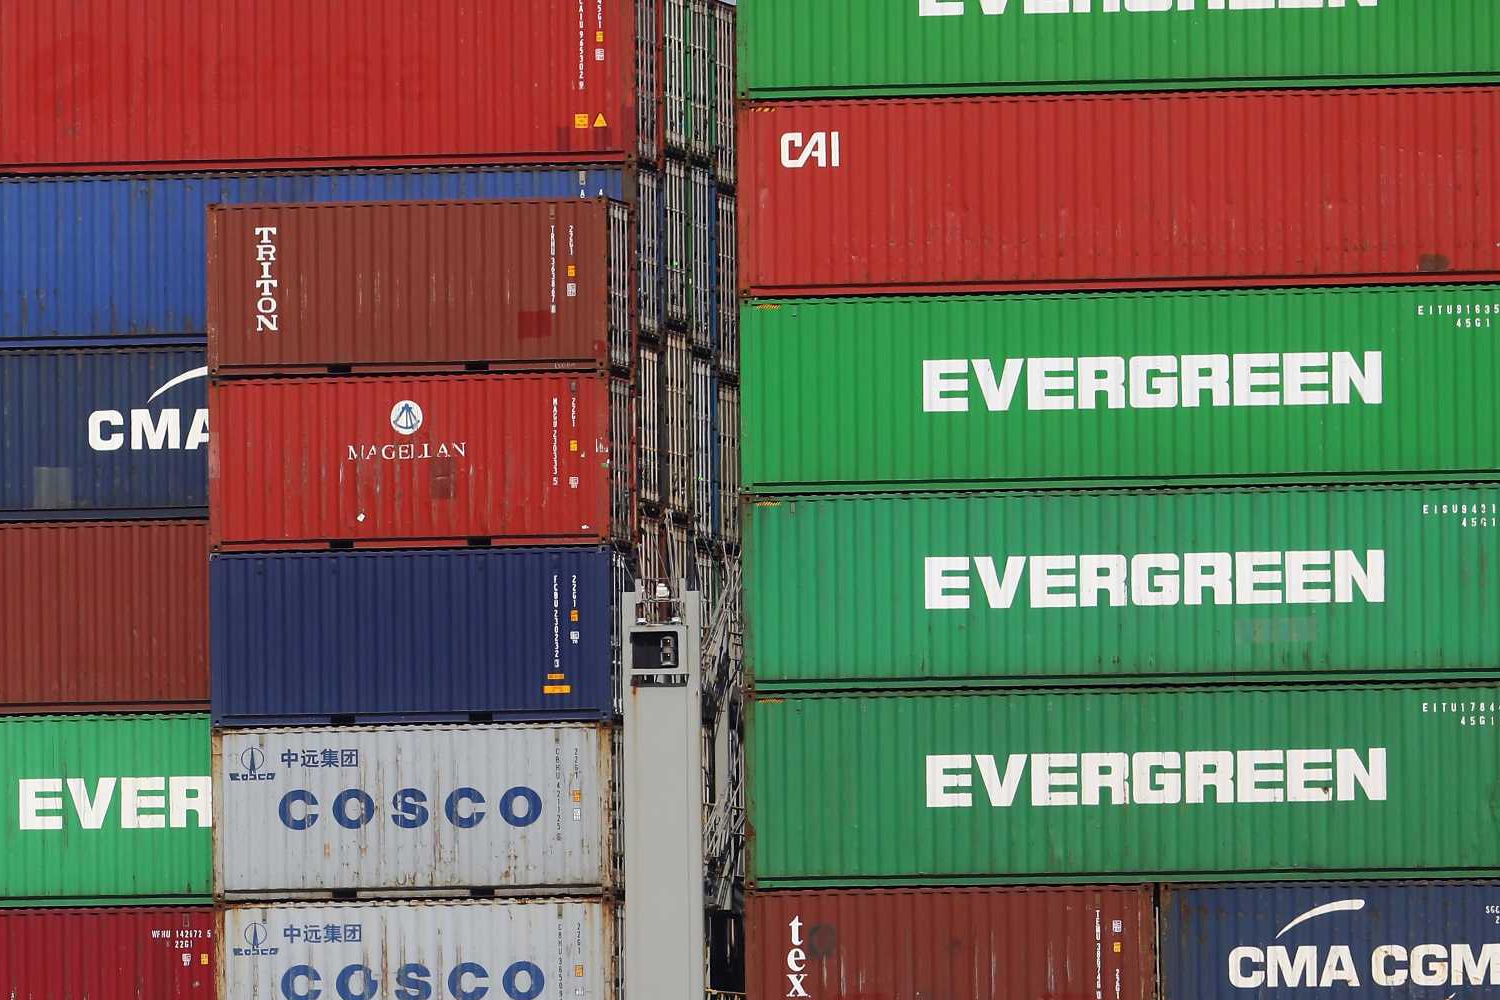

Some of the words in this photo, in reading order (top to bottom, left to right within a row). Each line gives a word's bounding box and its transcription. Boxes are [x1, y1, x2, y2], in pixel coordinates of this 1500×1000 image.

[780, 131, 841, 168] CAI
[255, 226, 279, 332] TRITON
[1456, 318, 1490, 328] 45G1
[922, 351, 1383, 413] EVERGREEN
[348, 442, 467, 461] MAGELLAN
[924, 549, 1385, 610] EVERGREEN
[1422, 702, 1500, 713] EITU1784
[281, 748, 359, 768] 中远集团
[926, 748, 1388, 808] EVERGREEN
[19, 776, 213, 830] EVER
[278, 786, 542, 831] COSCO
[283, 924, 362, 944] 中远集团
[786, 915, 809, 998] tex
[1228, 945, 1360, 988] CMA
[1371, 943, 1500, 986] CGM
